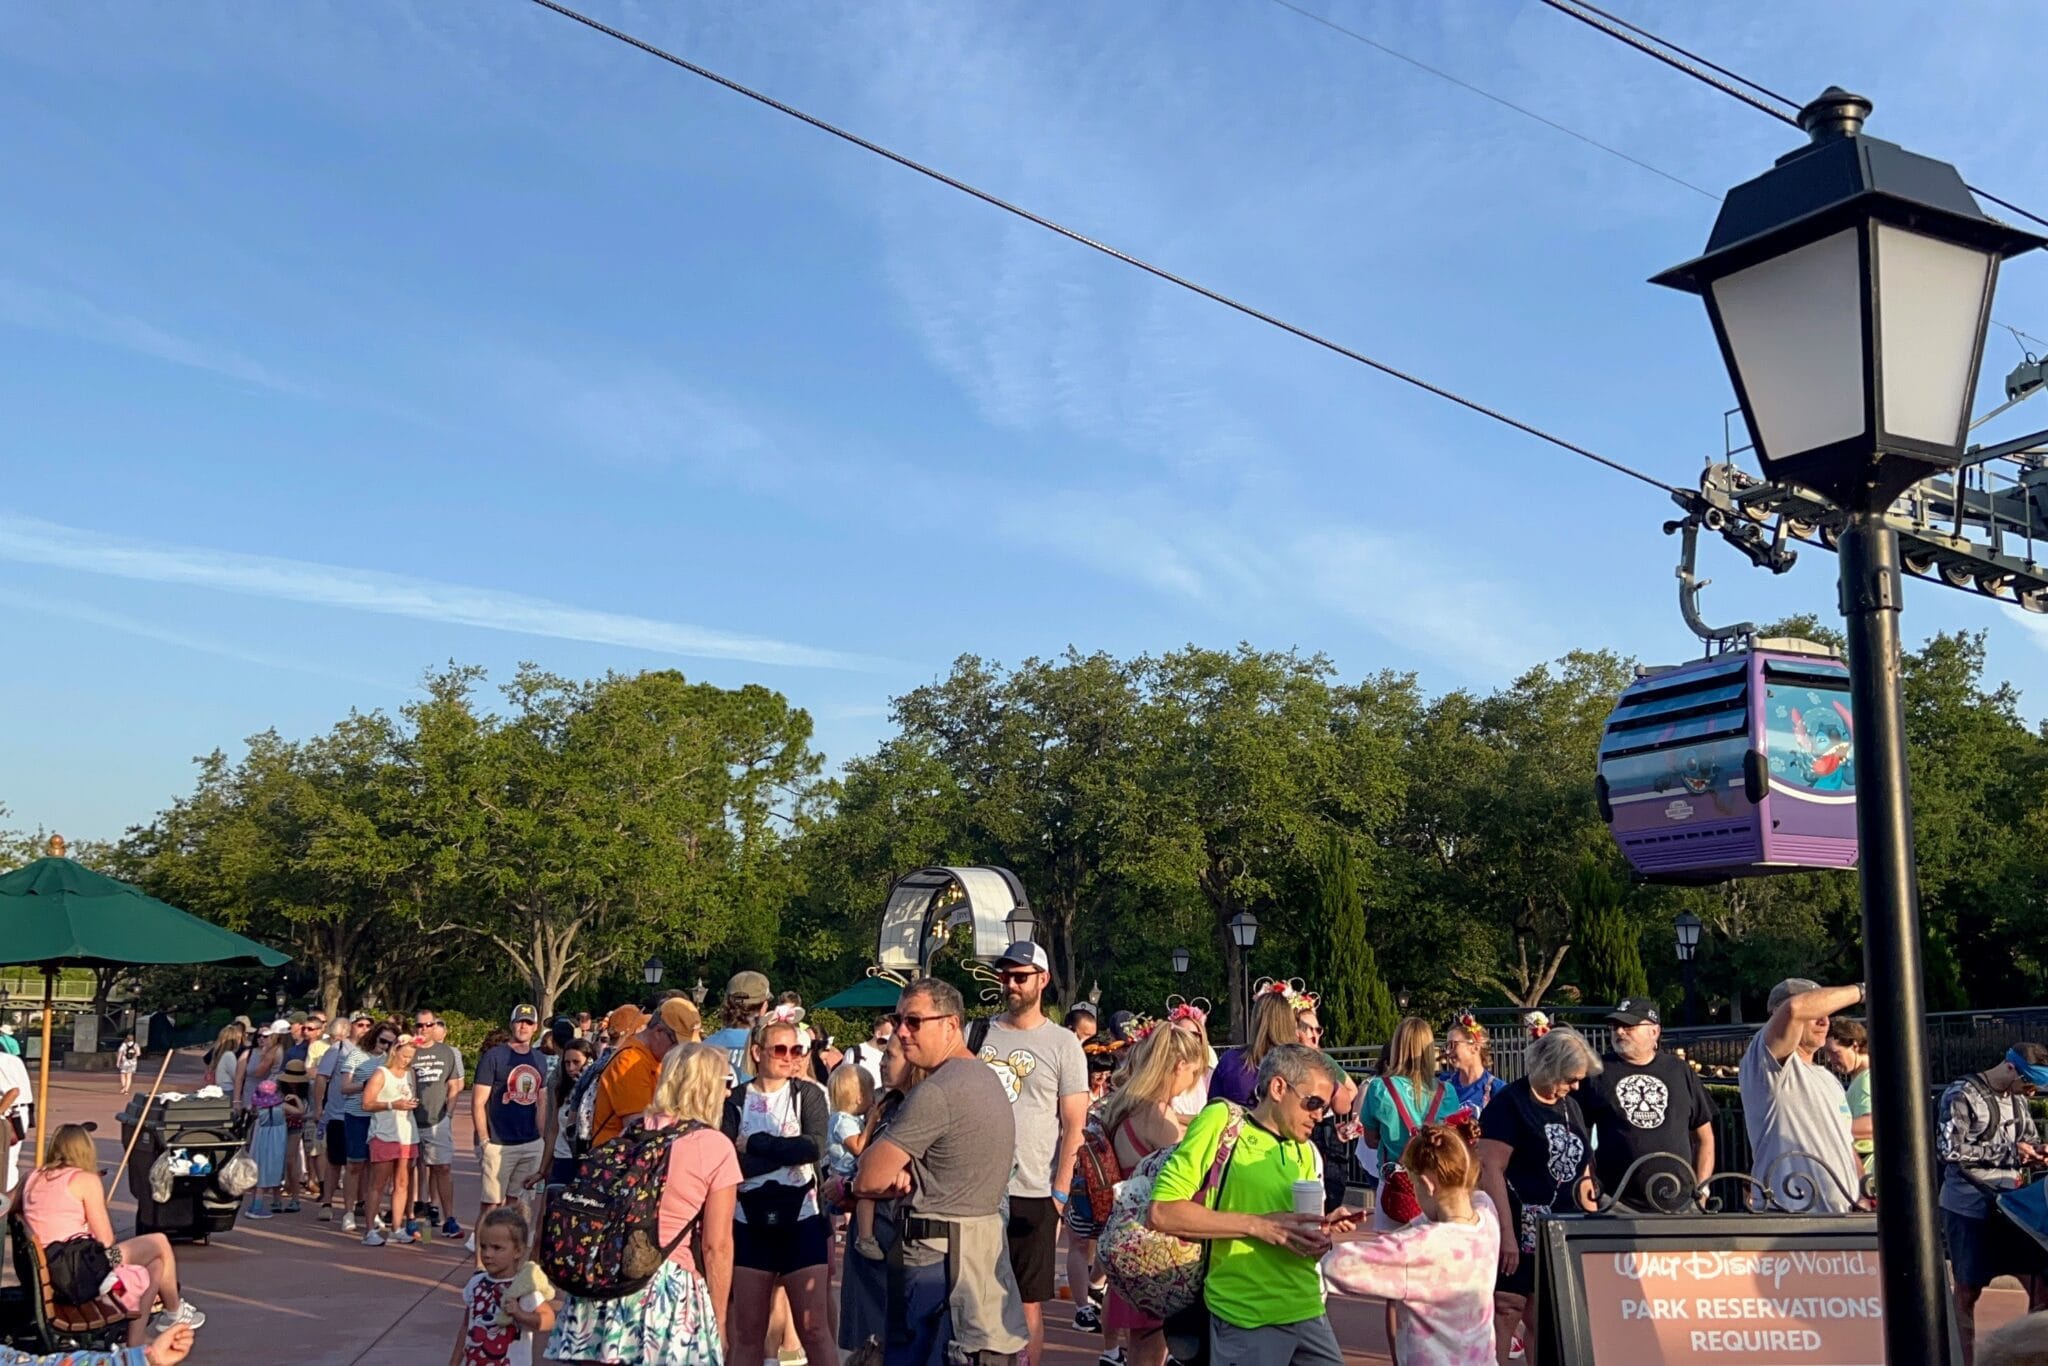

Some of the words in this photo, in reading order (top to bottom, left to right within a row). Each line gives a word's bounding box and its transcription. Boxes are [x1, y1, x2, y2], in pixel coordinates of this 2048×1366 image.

[1621, 1298, 1690, 1320] PARK
[1695, 1297, 1883, 1319] RESERVATIONS
[1690, 1330, 1822, 1352] REQUIRED
